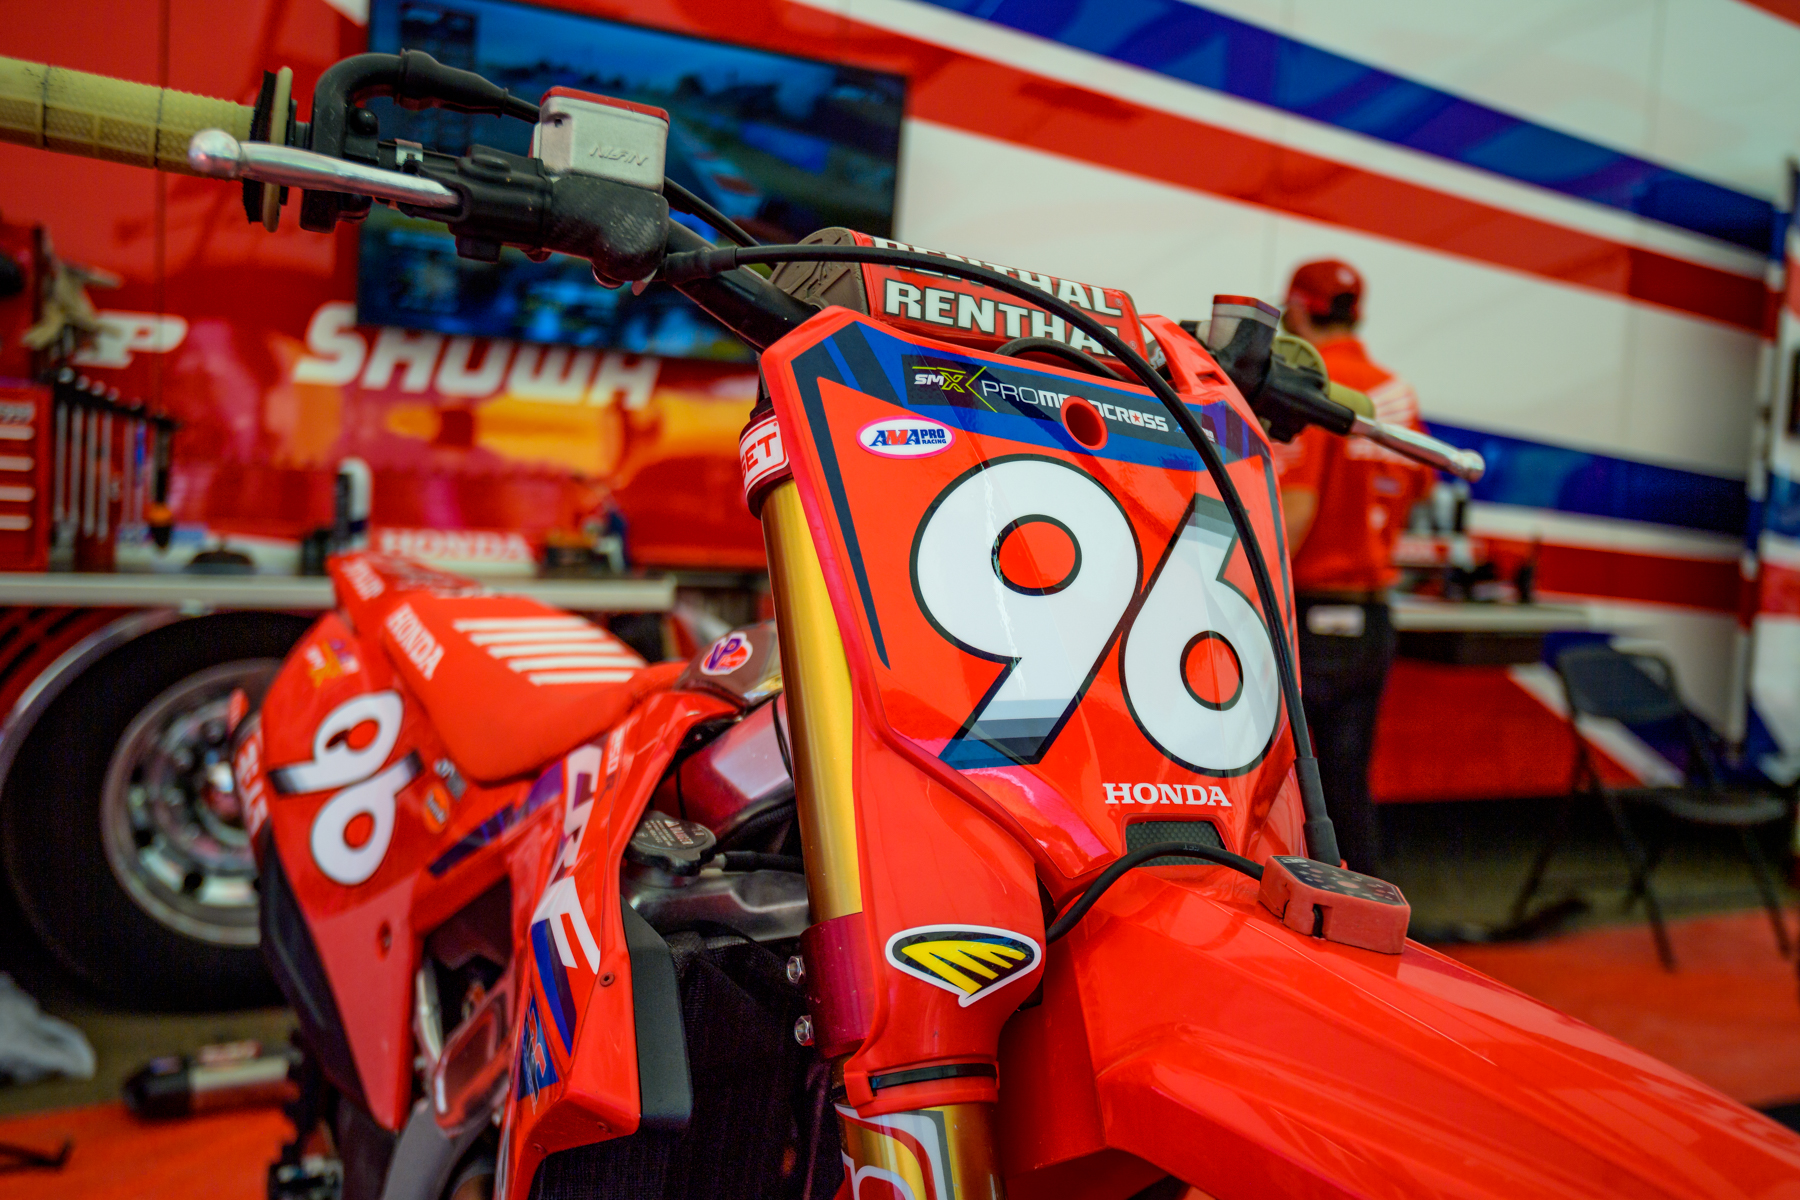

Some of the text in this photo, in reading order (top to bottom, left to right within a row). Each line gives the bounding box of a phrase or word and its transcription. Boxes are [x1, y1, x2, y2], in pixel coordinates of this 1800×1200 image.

[913, 370, 966, 394] SMX
[981, 380, 1169, 433] PROMCROSS
[868, 428, 946, 447] AMA PRO
[386, 602, 445, 682] HONDA
[911, 453, 1282, 779] 96
[1102, 782, 1233, 807] HONDA
